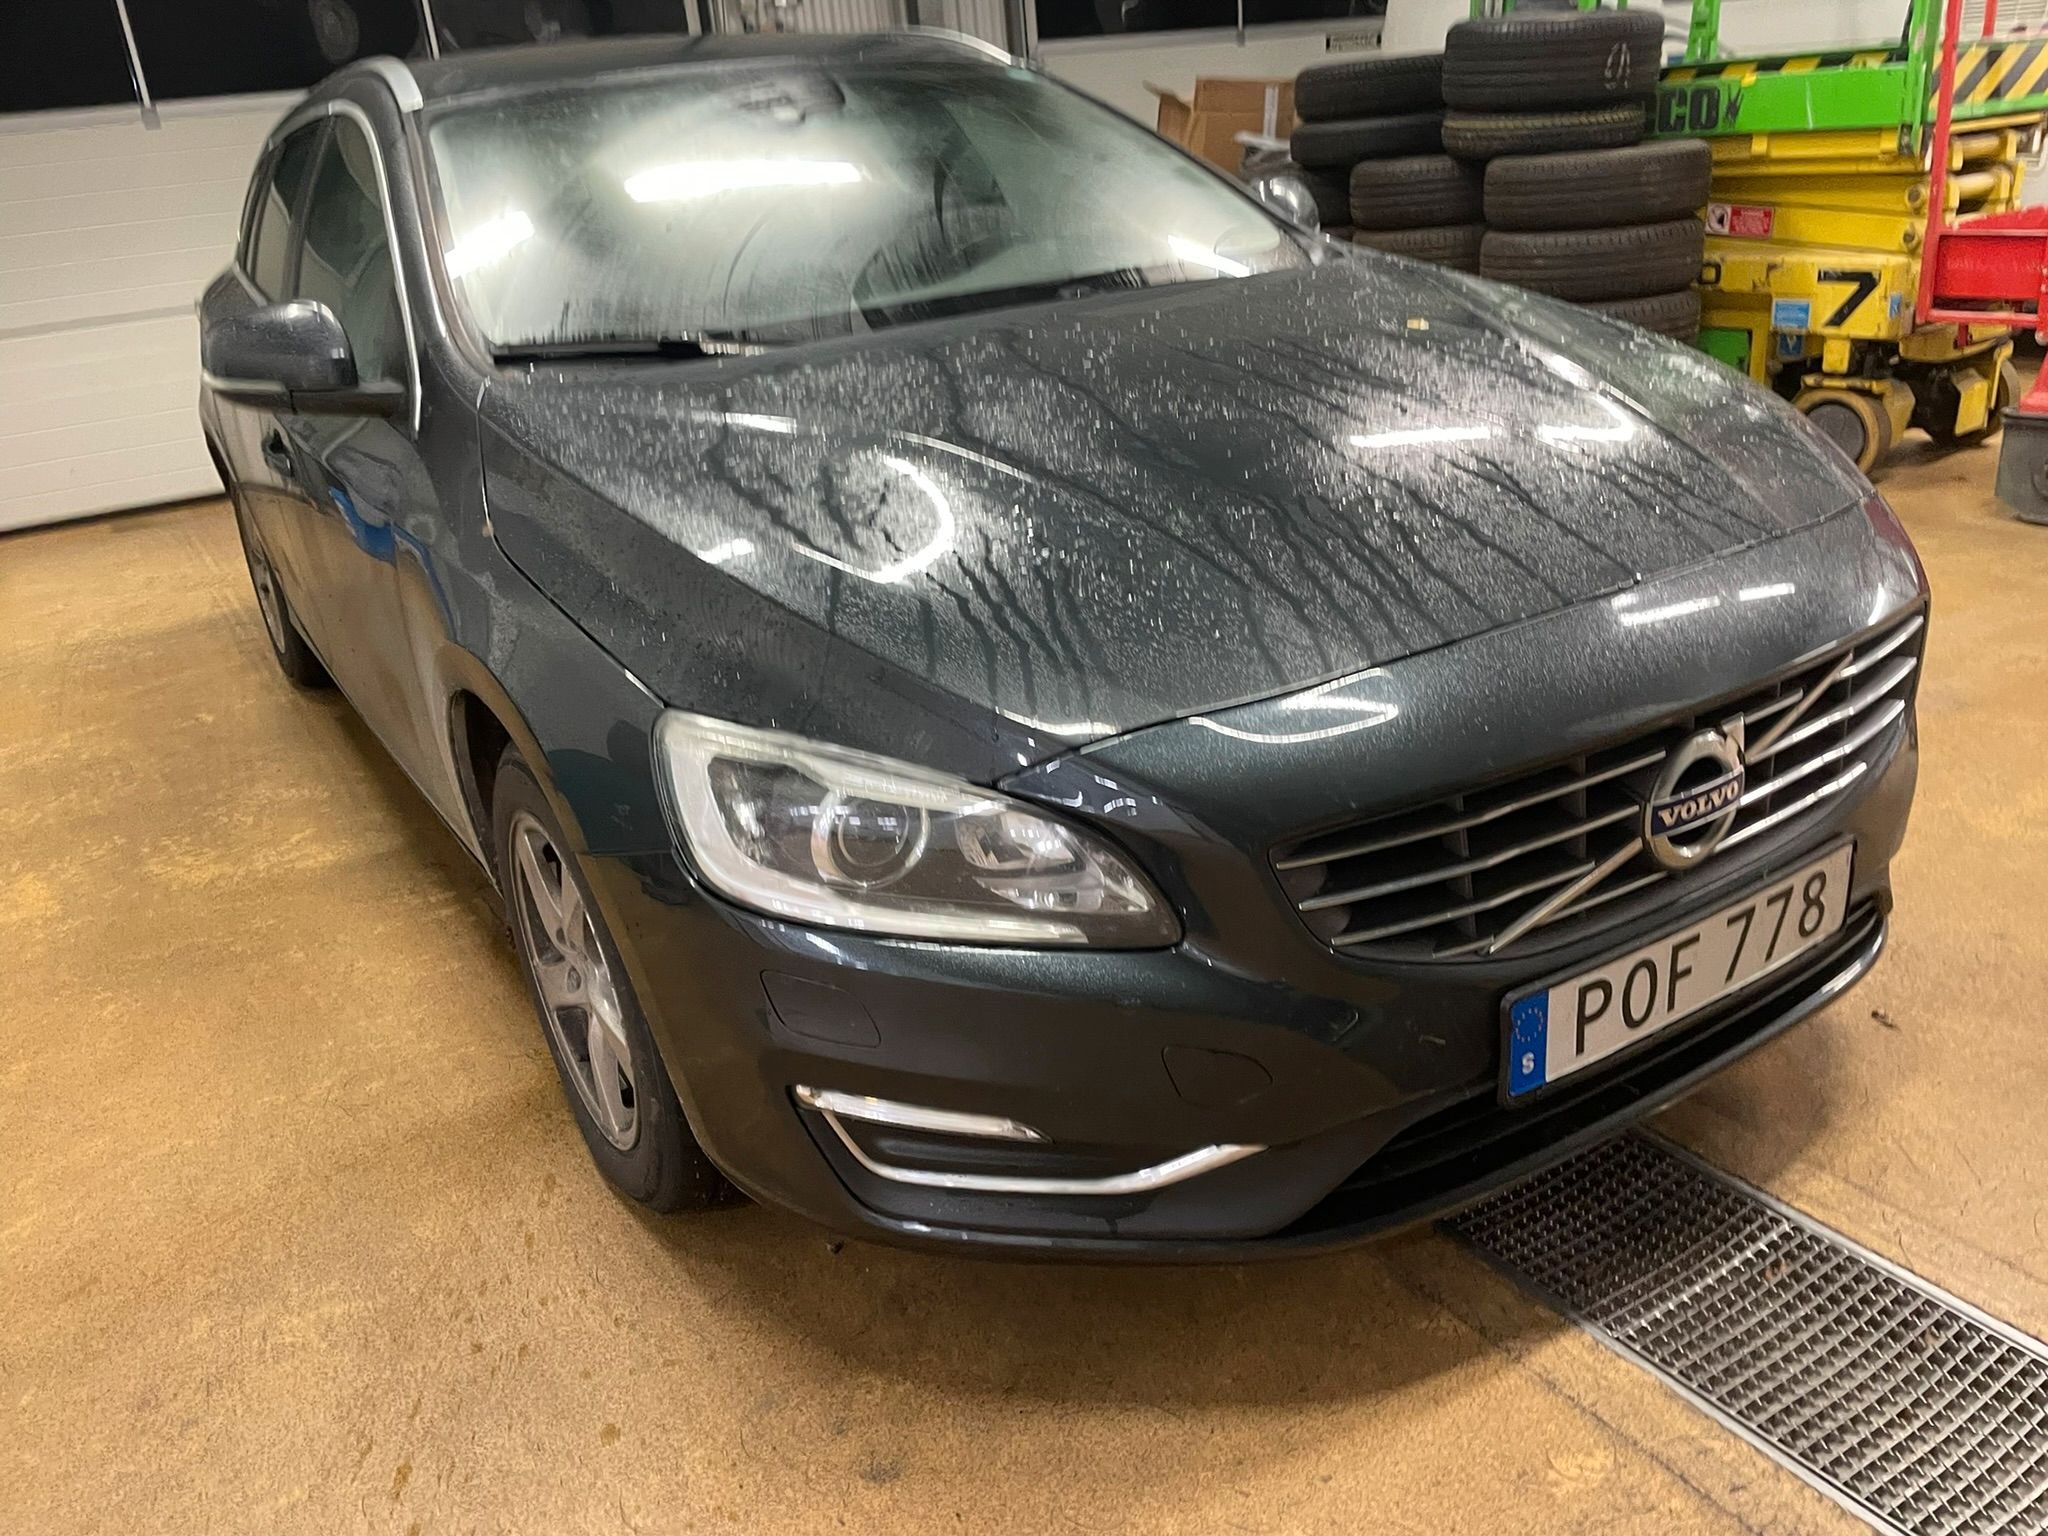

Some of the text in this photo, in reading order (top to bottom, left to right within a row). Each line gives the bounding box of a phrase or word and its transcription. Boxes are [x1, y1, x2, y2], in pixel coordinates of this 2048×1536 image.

[1817, 269, 1881, 327] 7
[1658, 780, 1739, 827] VOLVO
[1576, 871, 1827, 1056] POF 778
[1521, 1052, 1536, 1074] S
